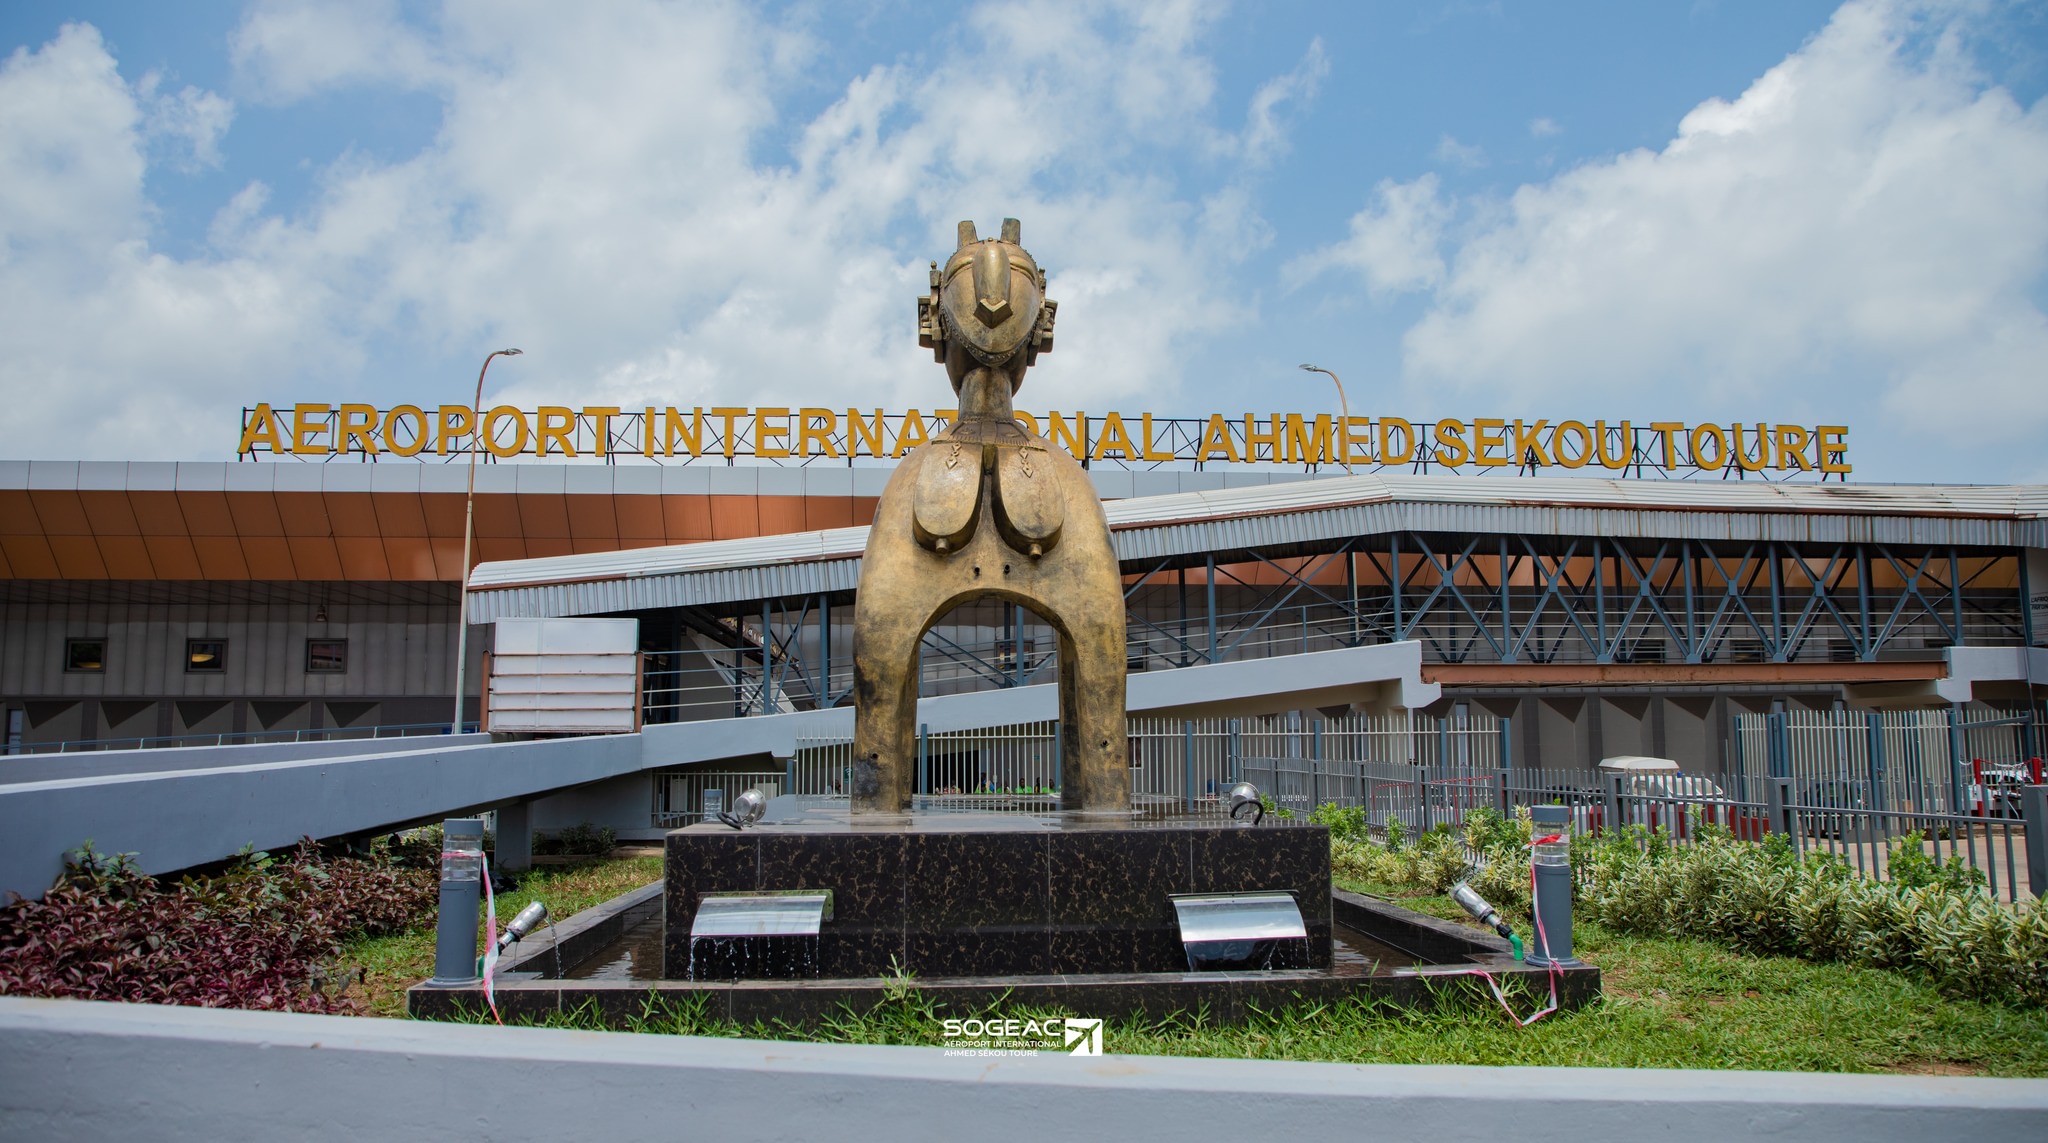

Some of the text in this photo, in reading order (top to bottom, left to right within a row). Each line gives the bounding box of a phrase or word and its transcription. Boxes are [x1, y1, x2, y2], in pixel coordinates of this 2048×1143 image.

[237, 402, 621, 458] AEROPORT
[1199, 412, 1415, 466] AHMED
[1434, 418, 1633, 470] SEKOU
[1650, 421, 1853, 474] TOURE
